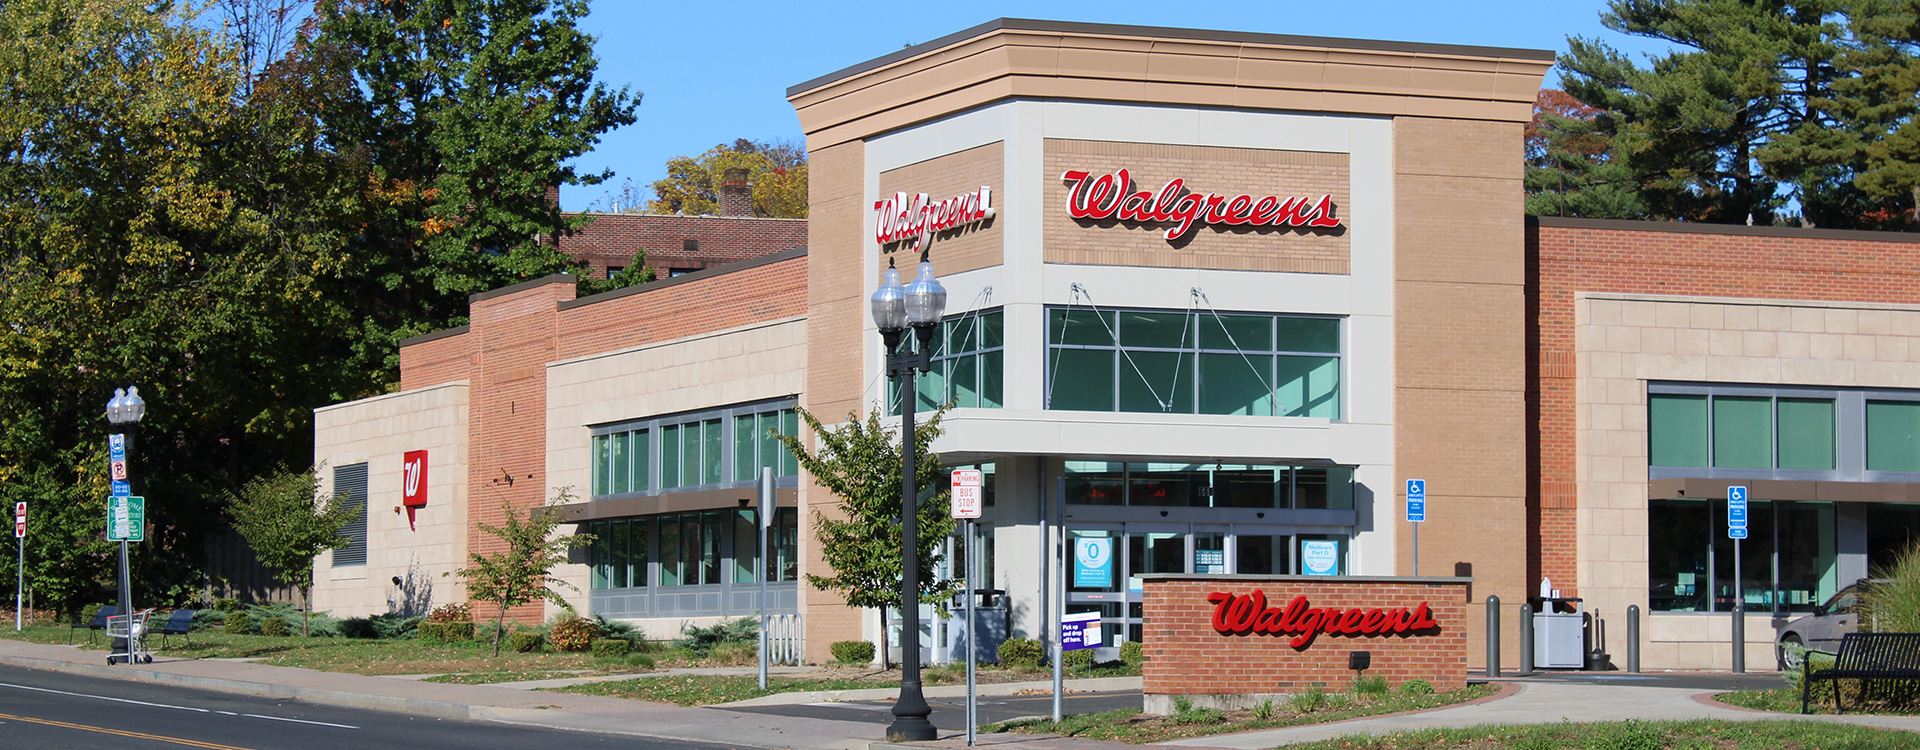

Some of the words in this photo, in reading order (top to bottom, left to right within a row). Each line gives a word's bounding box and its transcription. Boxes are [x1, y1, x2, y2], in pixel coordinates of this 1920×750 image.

[874, 187, 991, 253] Walgreens
[1060, 168, 1341, 240] Walgreens
[405, 458, 421, 497] W
[960, 488, 973, 497] BUS
[958, 498, 975, 507] STOP
[1207, 589, 1437, 648] Walgreens
